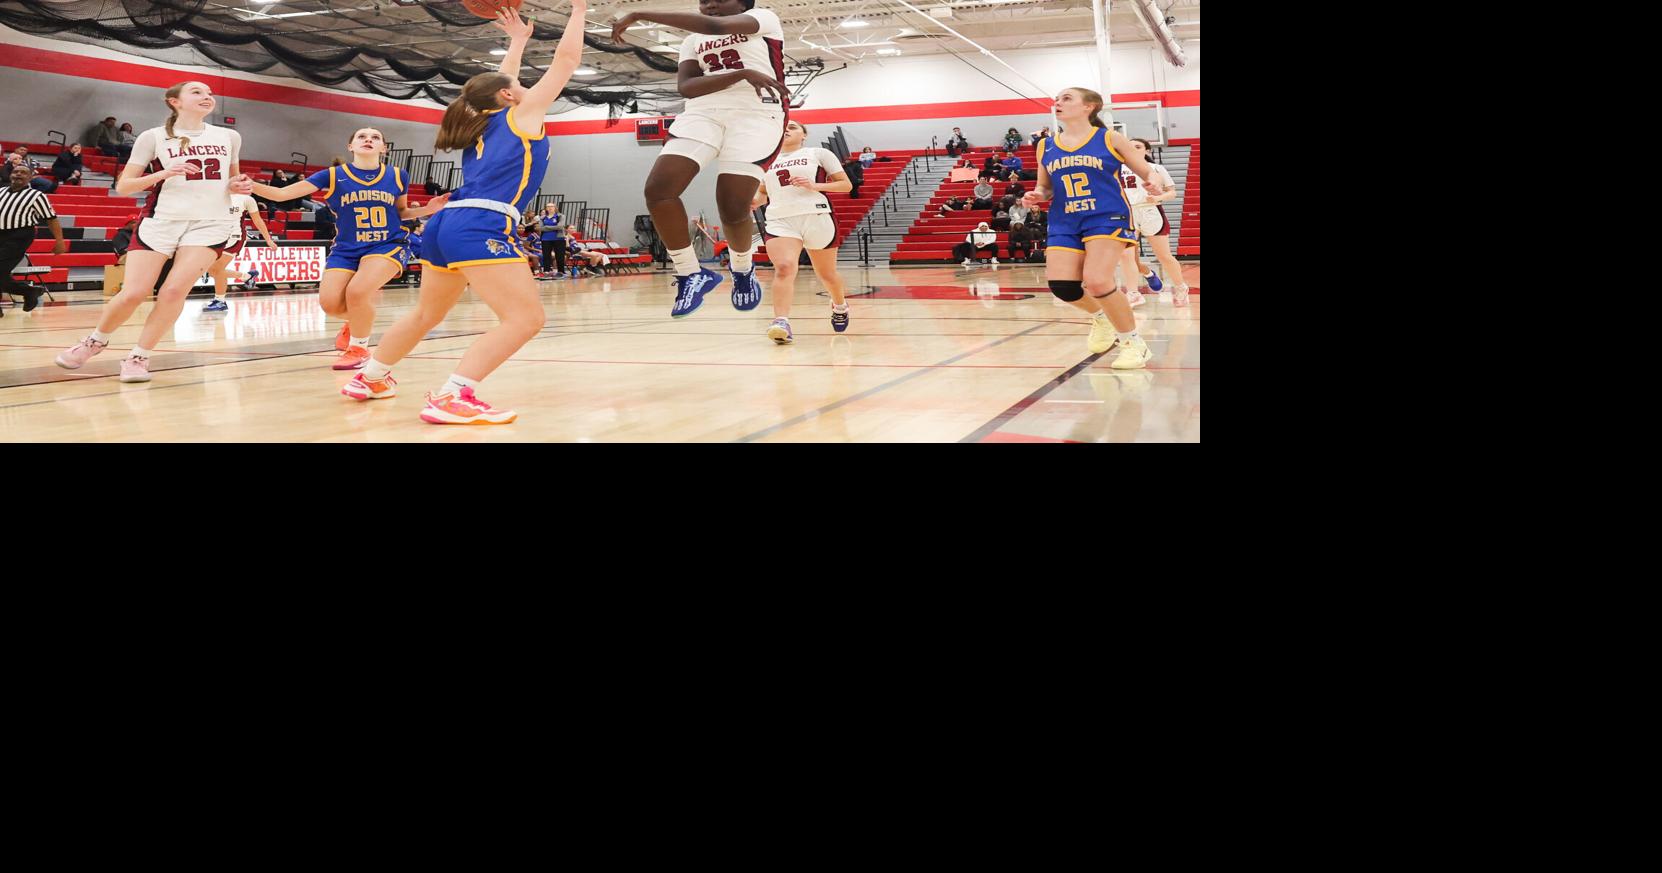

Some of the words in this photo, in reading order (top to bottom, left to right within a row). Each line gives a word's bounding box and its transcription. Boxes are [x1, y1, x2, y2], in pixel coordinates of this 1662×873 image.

[695, 33, 749, 54] ANCERS
[703, 48, 745, 72] 32
[168, 145, 227, 158] LANCERS
[185, 158, 221, 181] 22
[768, 158, 808, 170] ANCERS
[1046, 155, 1104, 175] MADISON
[776, 169, 791, 187] 2
[1061, 172, 1092, 198] 12
[341, 190, 395, 207] MADISON
[1064, 198, 1097, 214] WEST
[353, 206, 388, 229] 20
[356, 230, 389, 242] WEST
[256, 247, 320, 261] FOLLETTE
